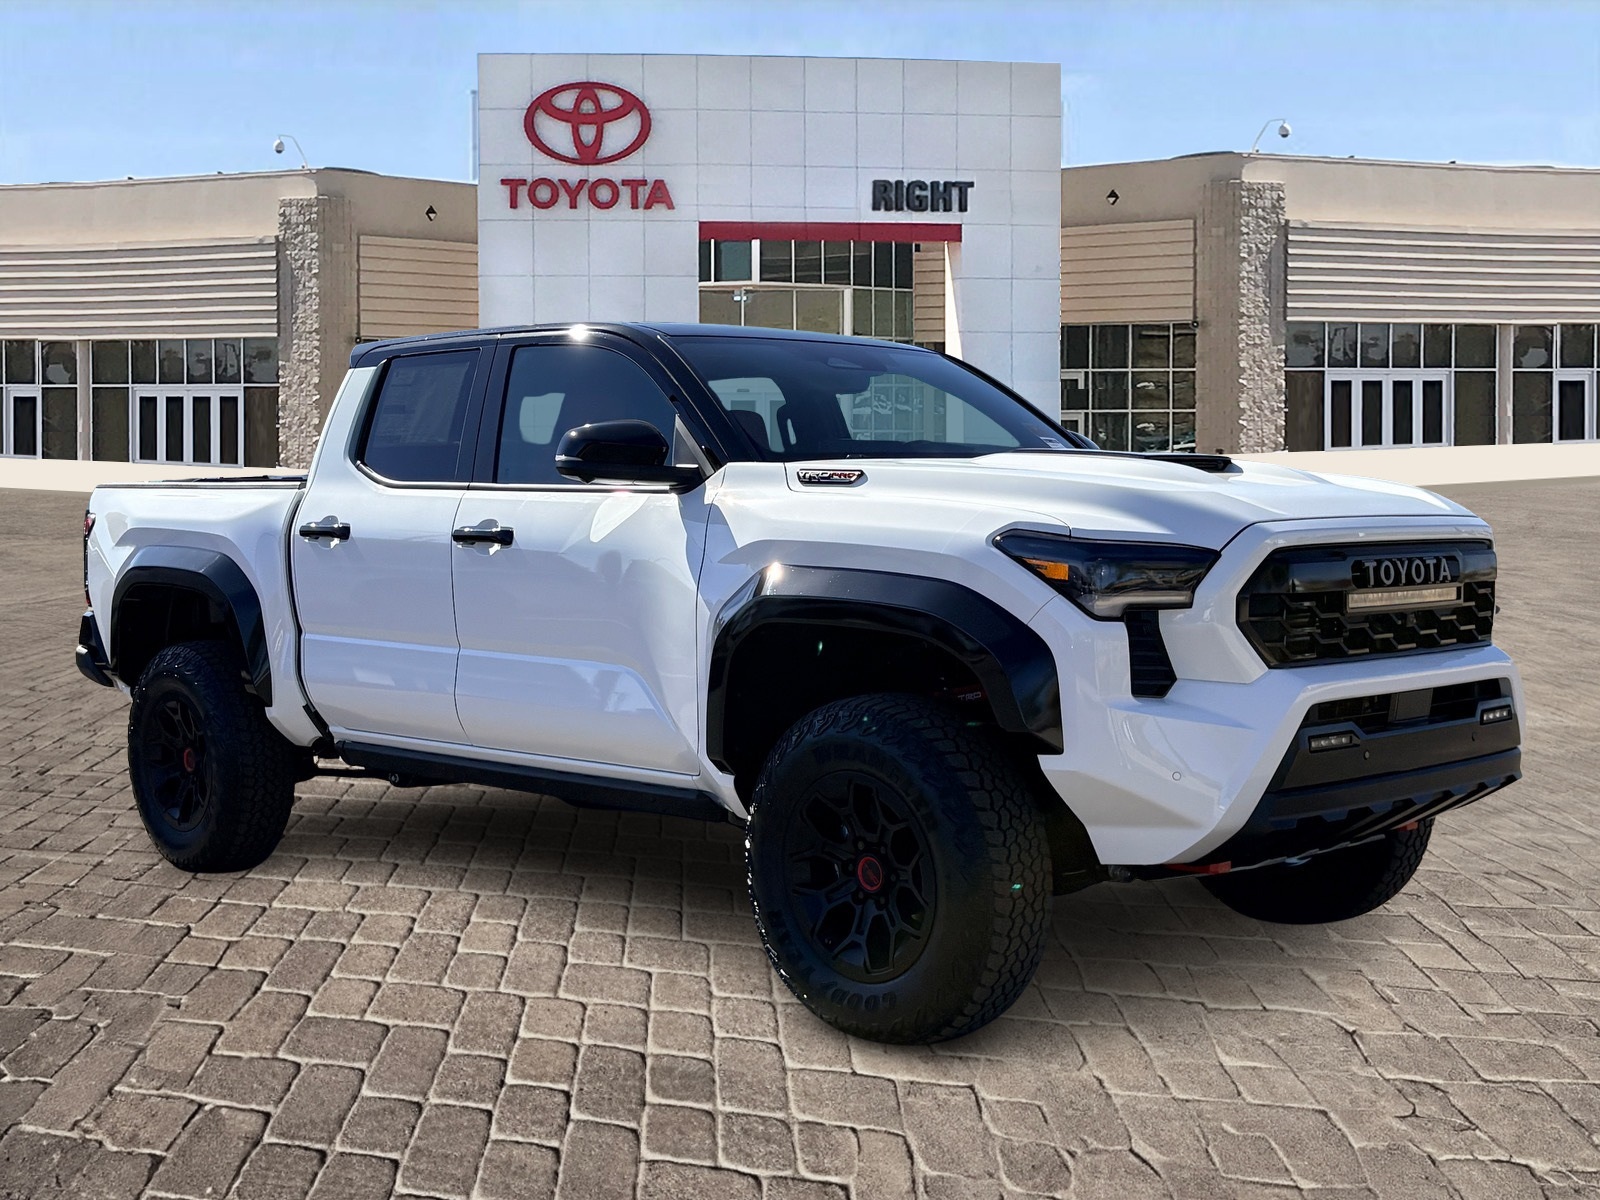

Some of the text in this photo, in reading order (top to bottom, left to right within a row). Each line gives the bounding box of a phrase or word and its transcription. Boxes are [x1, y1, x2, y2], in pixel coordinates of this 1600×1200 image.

[500, 177, 675, 210] TOYOTA
[872, 179, 975, 212] RIGHT
[799, 470, 830, 481] TRD
[1362, 555, 1451, 588] TOYOTA
[957, 691, 982, 702] TRD
